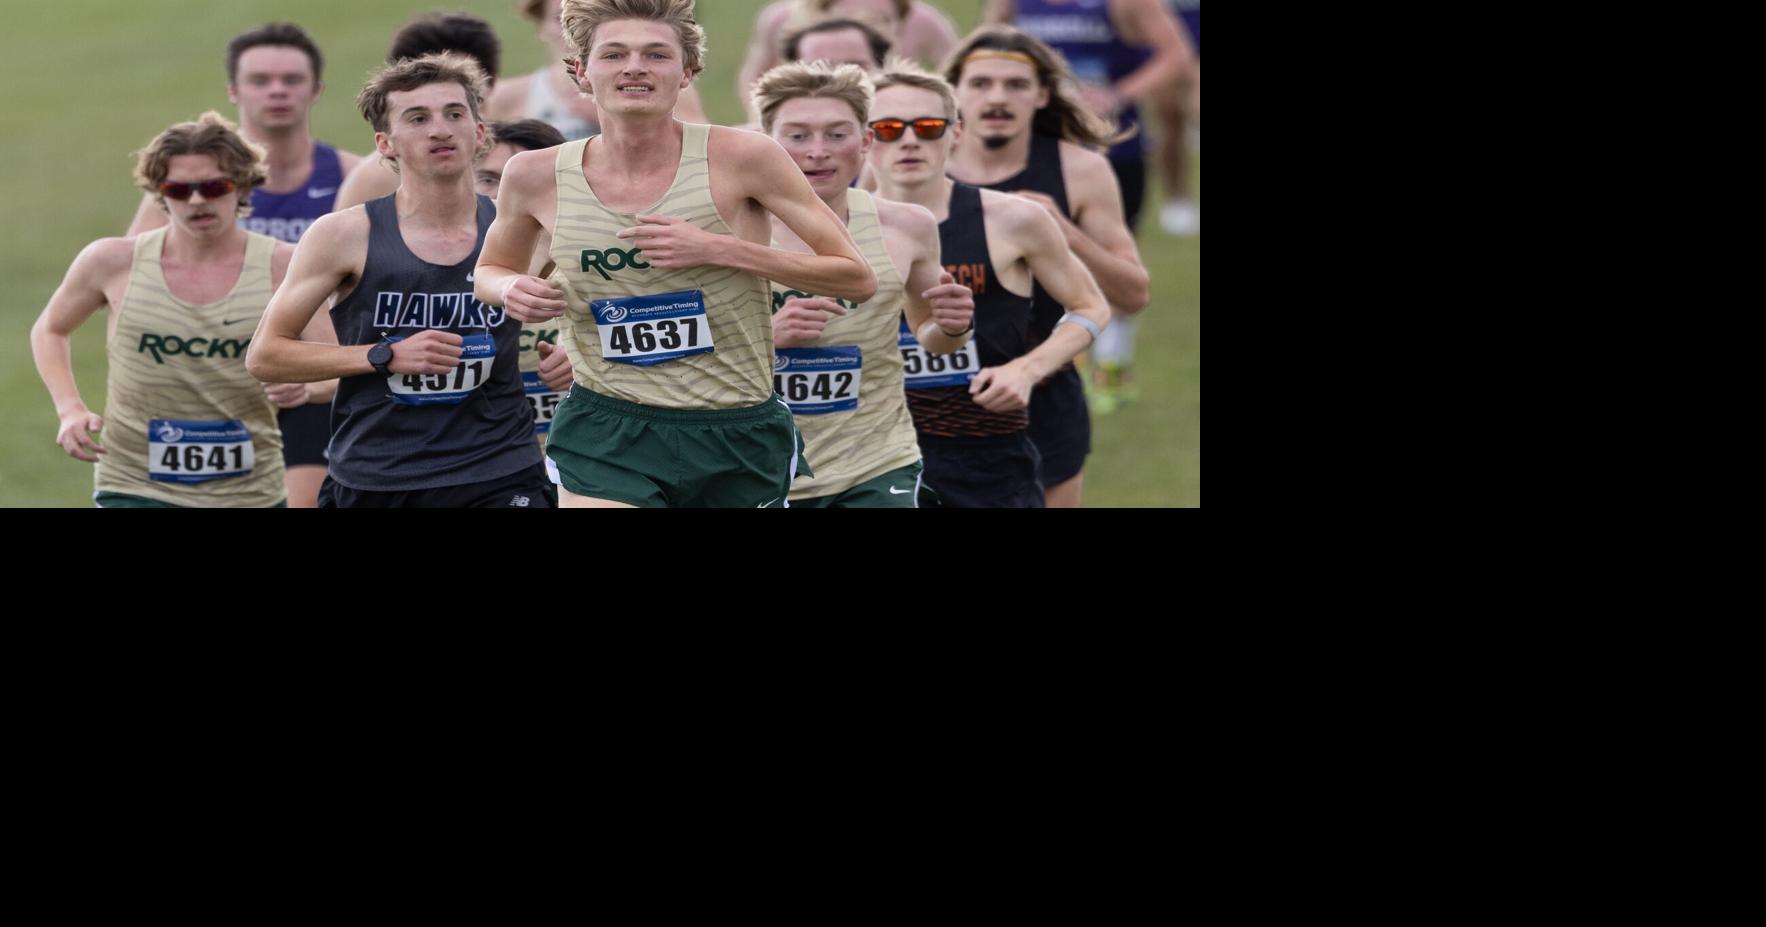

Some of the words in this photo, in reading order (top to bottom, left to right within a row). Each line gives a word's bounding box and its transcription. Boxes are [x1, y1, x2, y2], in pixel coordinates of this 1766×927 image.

[581, 247, 655, 280] ROC
[373, 292, 506, 328] HAWKS
[138, 334, 252, 364] ROCKY
[519, 329, 559, 351] CK
[610, 318, 698, 354] 4637
[902, 346, 970, 374] 586
[161, 445, 243, 471] 4641
